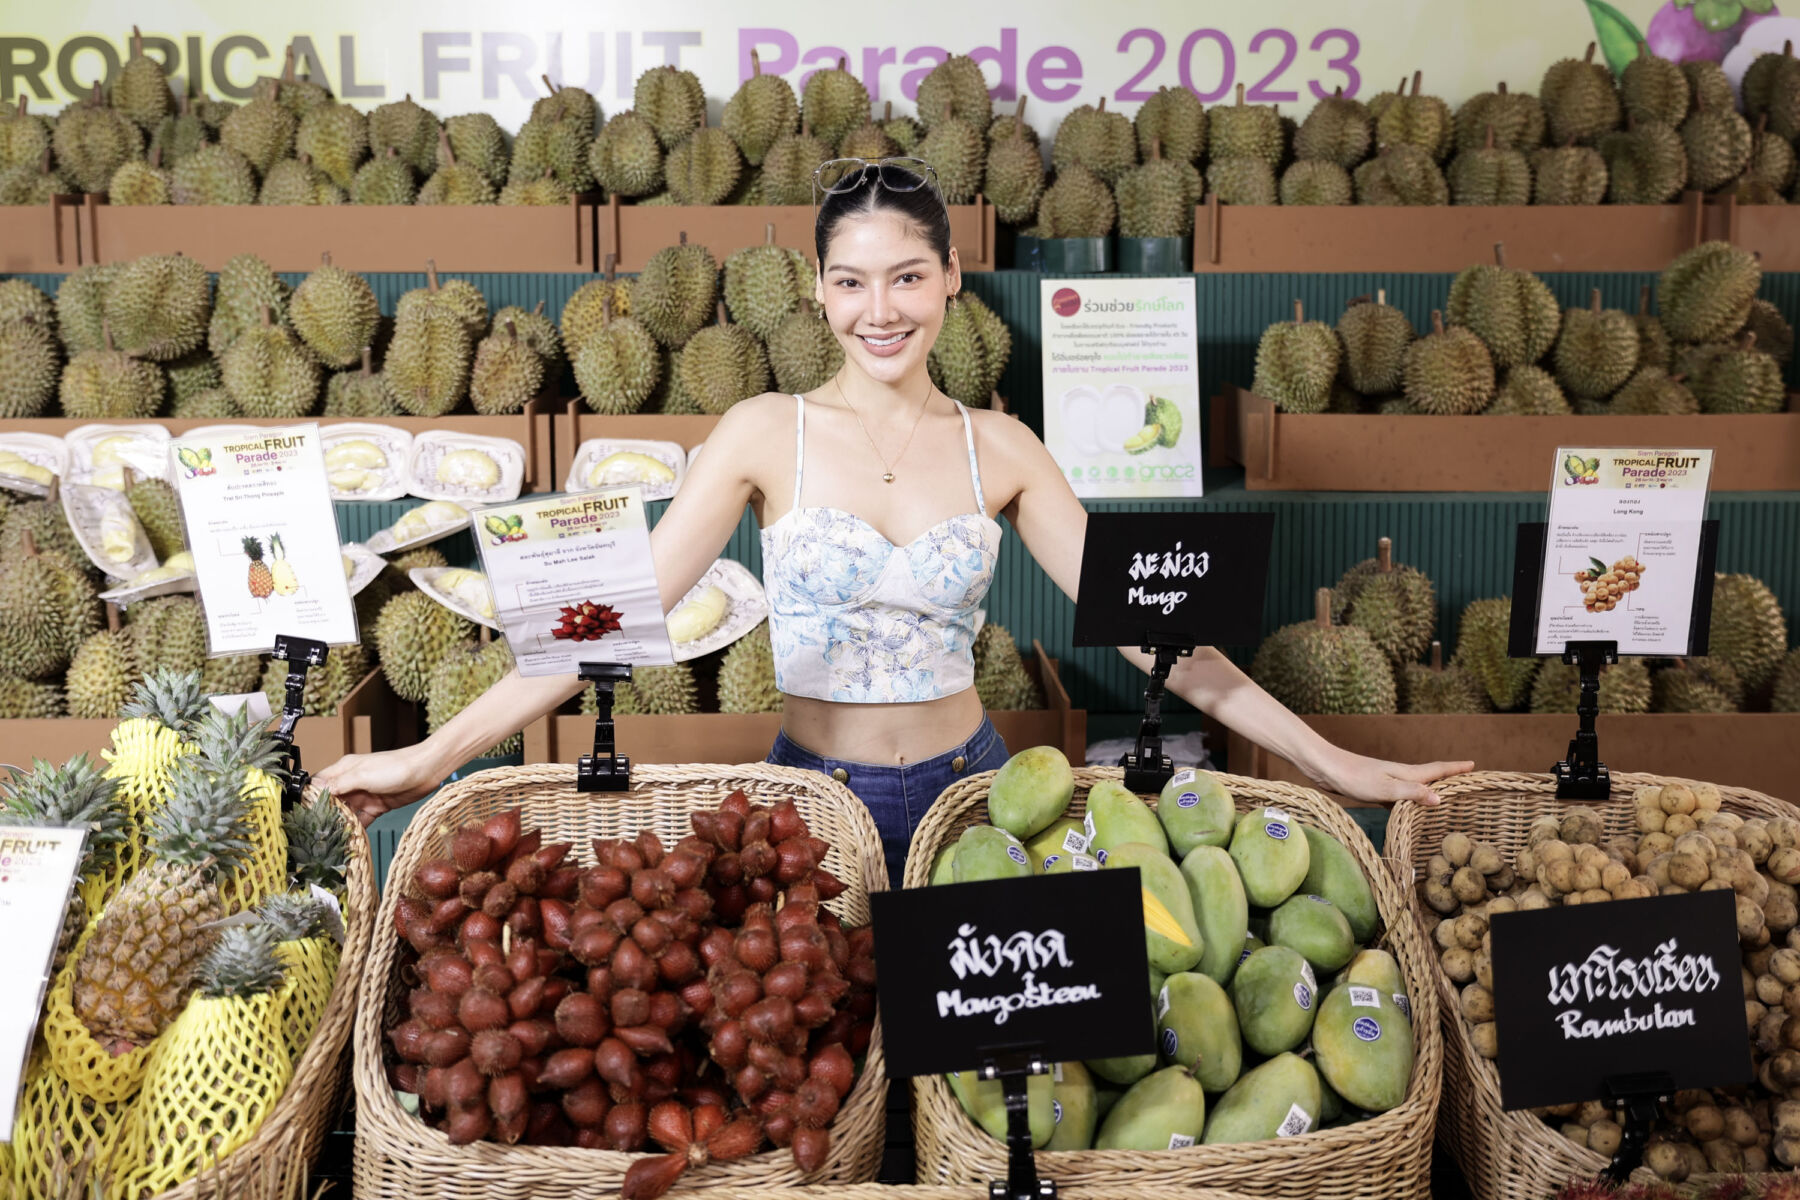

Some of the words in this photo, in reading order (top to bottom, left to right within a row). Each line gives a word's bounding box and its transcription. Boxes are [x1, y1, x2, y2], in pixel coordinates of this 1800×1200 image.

[421, 31, 703, 100] FRUIT
[1114, 28, 1361, 103] 2023
[223, 442, 264, 454] TROPICAL
[264, 435, 305, 452] FRUIT
[235, 451, 278, 464] Parade
[279, 449, 298, 458] 2023
[1612, 458, 1656, 467] TROPICAL
[1655, 457, 1700, 468] FRUIT
[1622, 467, 1666, 477] Parade
[1667, 469, 1688, 477] 2023
[536, 506, 583, 520] TROPICAL
[583, 496, 629, 515] FRUIT
[550, 514, 598, 528] Parade
[599, 511, 620, 520] 2023
[1128, 540, 1210, 581] มะม่วง
[1128, 586, 1188, 615] Mango
[1546, 937, 1720, 1006] เงาะโรงเรียน
[1554, 1002, 1696, 1040] Rambutan
